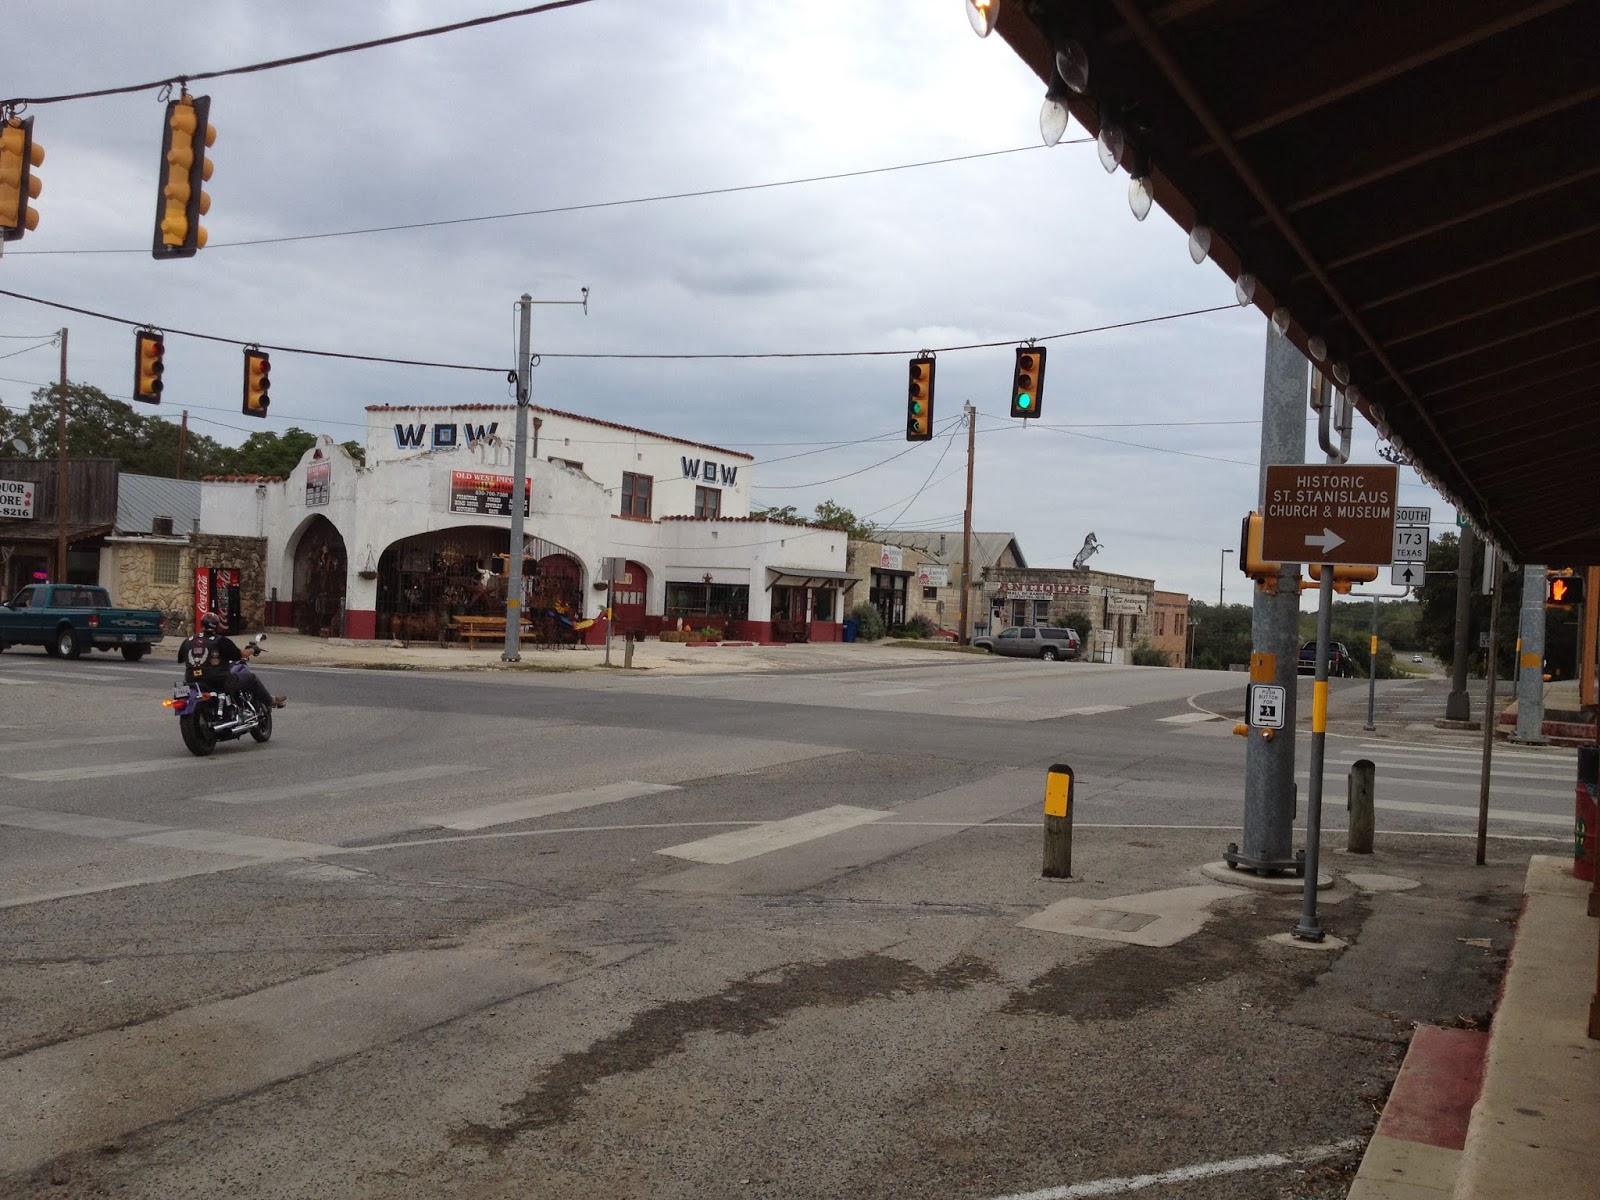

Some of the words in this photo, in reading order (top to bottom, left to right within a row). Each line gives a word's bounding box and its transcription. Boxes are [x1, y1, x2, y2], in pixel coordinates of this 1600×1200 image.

[456, 472, 472, 480] OLD
[496, 476, 529, 484] IMPOS
[1296, 475, 1364, 488] HISTORIC
[0, 482, 24, 493] UOR
[1273, 490, 1292, 502] ST.
[1296, 490, 1389, 504] STANISLAUS
[1269, 504, 1318, 517] CHURCH
[1322, 505, 1332, 518] &
[1337, 506, 1391, 519] MUSEUM
[1396, 510, 1428, 521] SOUTH
[1398, 533, 1422, 545] 173
[1396, 549, 1423, 557] TEXAS
[999, 582, 1090, 594] ANTIQUES
